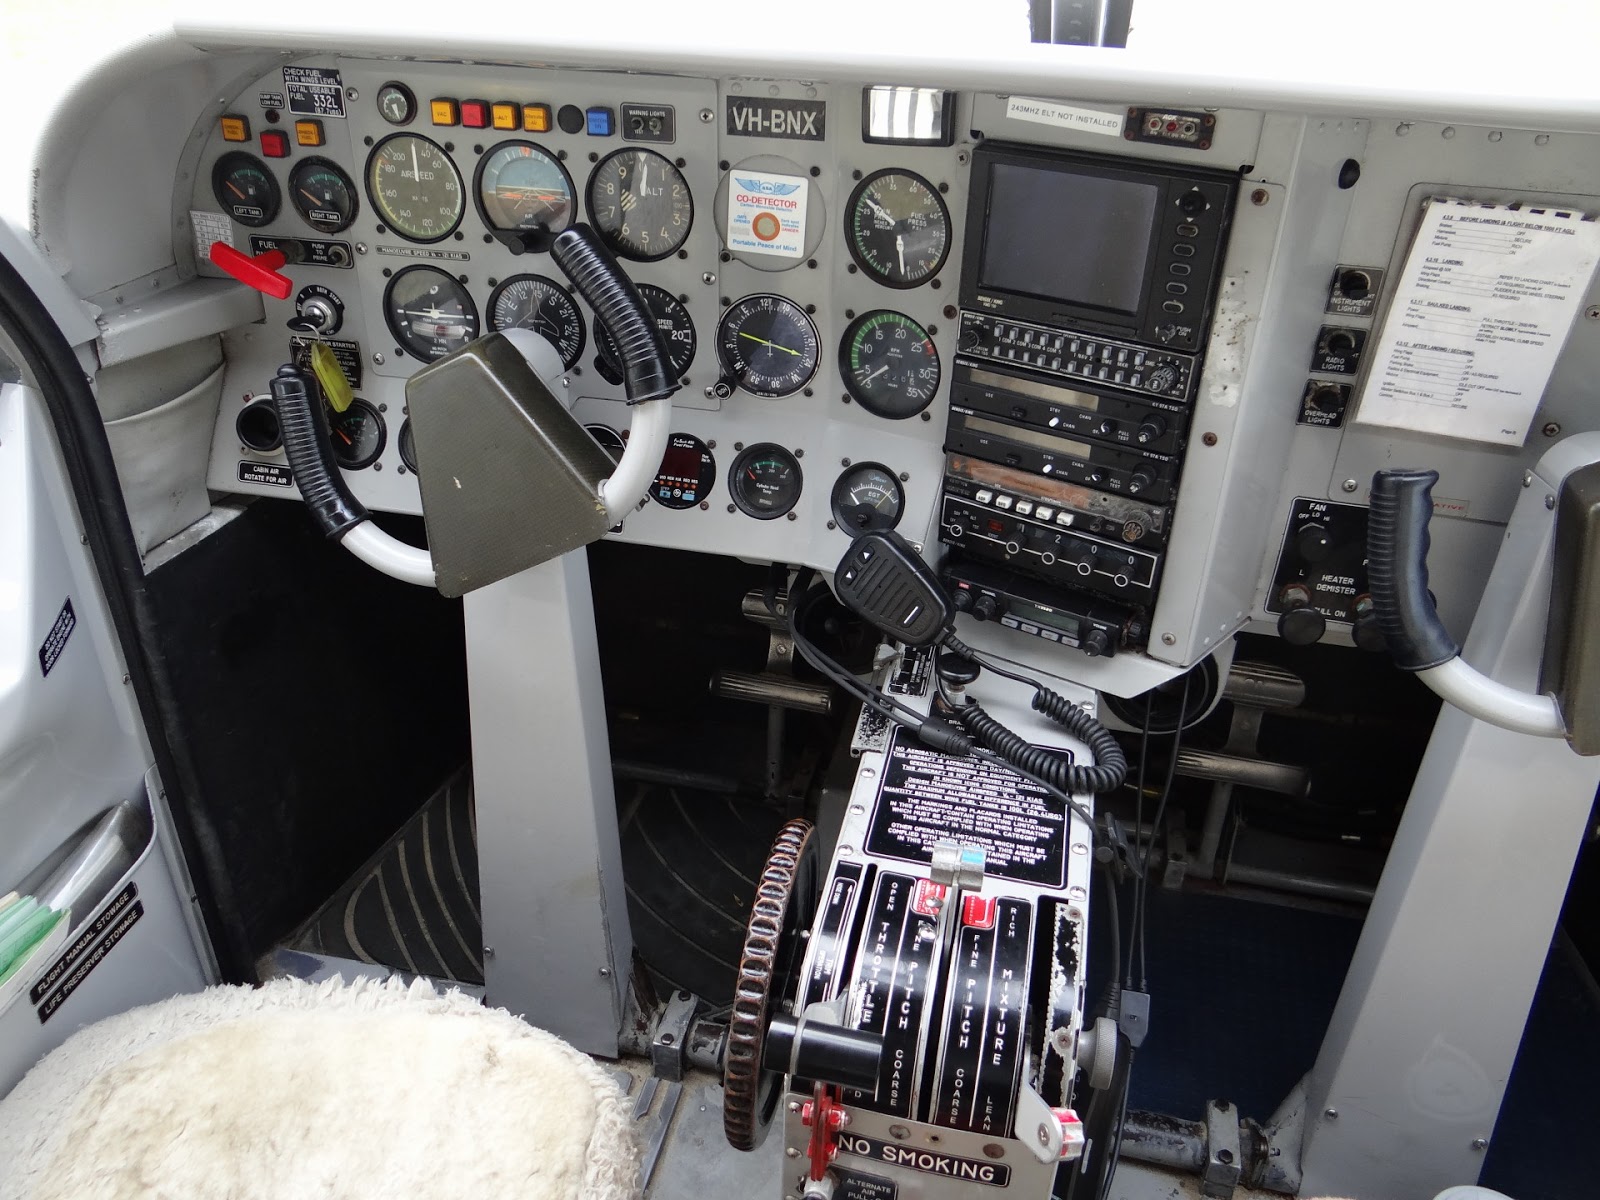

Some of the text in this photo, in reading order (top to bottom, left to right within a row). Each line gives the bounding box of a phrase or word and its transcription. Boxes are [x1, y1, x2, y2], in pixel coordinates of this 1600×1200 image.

[283, 67, 321, 77] CHECK FUEL
[300, 76, 319, 84] WINGS
[288, 84, 336, 95] TOTAL USEABLE
[313, 94, 338, 108] 332L
[629, 109, 648, 117] WARNING
[1010, 104, 1118, 129] 243MHZ ELT NOT INSTALLED
[732, 106, 817, 136] VH-BNX
[392, 152, 405, 161] 200
[420, 150, 431, 158] 40
[384, 164, 396, 173] 180
[432, 161, 442, 169] 60
[401, 170, 434, 181] AIRSEED
[618, 166, 627, 179] 9
[445, 182, 455, 191] 80
[607, 183, 614, 195] 8
[672, 184, 680, 196] 2
[385, 189, 397, 197] 160
[736, 193, 797, 209] CO-DETECTOR
[399, 209, 411, 217] 140
[439, 207, 451, 215] 100
[608, 205, 615, 218] 7
[911, 212, 926, 220] FUEL
[422, 218, 433, 227] 120
[672, 212, 681, 225] 3
[908, 219, 927, 227] PRESS
[621, 222, 630, 235] 6
[660, 226, 669, 238] 4
[641, 231, 649, 243] 5
[259, 241, 278, 249] FUEL
[732, 238, 756, 248] Portable
[757, 241, 774, 250] Peace
[783, 244, 797, 252] Mind
[518, 291, 528, 300] 12
[549, 296, 557, 306] S
[1331, 297, 1372, 307] INSTRUMENT
[559, 308, 568, 319] 21
[1337, 305, 1361, 313] LIGHTS
[657, 318, 673, 326] SPEED
[564, 324, 573, 336] 24
[875, 330, 884, 340] 15
[894, 329, 906, 339] 20
[671, 330, 684, 341] 20
[864, 343, 873, 353] 10
[911, 342, 922, 352] 25
[1325, 356, 1345, 364] RADIO
[865, 365, 871, 374] 5
[918, 369, 931, 379] 30
[771, 380, 781, 388] 30
[906, 388, 918, 397] 35
[1079, 413, 1092, 421] CHAN
[1304, 410, 1337, 419] OVERHEAD
[1307, 417, 1331, 425] LIGHTS
[253, 465, 280, 475] CABIN AIR
[244, 474, 287, 484] ROTATE FOR AIR
[1309, 503, 1327, 511] FAN
[1055, 534, 1061, 543] 2
[1322, 575, 1354, 585] HEATER
[1316, 584, 1356, 595] DEMISTER
[1334, 610, 1346, 618] ON
[921, 800, 953, 810] MARKINGS
[969, 808, 1002, 818] PLACARDS
[1003, 814, 1038, 824] INSTALLED
[902, 813, 918, 821] THIS
[918, 816, 950, 826] AIRCRAFT
[1003, 831, 1038, 842] CATEGORY
[888, 828, 938, 841] COMPLIED WITH
[891, 822, 913, 831] OTHER
[914, 826, 950, 837] OPERATING
[951, 832, 993, 844] LIMITATIONS
[994, 840, 1015, 849] WHICH
[1016, 844, 1035, 852] MUST
[887, 881, 898, 911] OPEN
[1008, 907, 1017, 938] RICH
[38, 892, 130, 995] FLIGHT MANUAL STOWAGE
[971, 934, 980, 968] FINE
[44, 909, 138, 1015] LIFE PRESERVER STOWAGE
[862, 921, 891, 1023] THROTTLE
[899, 961, 919, 1030] PITCH
[960, 978, 976, 1048] PITCH
[992, 968, 1013, 1066] MIXTURE
[890, 1049, 904, 1107] COARSE
[950, 1068, 964, 1124] COARSE
[983, 1095, 992, 1132] LEAN
[837, 1134, 996, 1182] NO SMOKING
[846, 1177, 892, 1194] ALTERNATE
[861, 1188, 876, 1197] AIR
